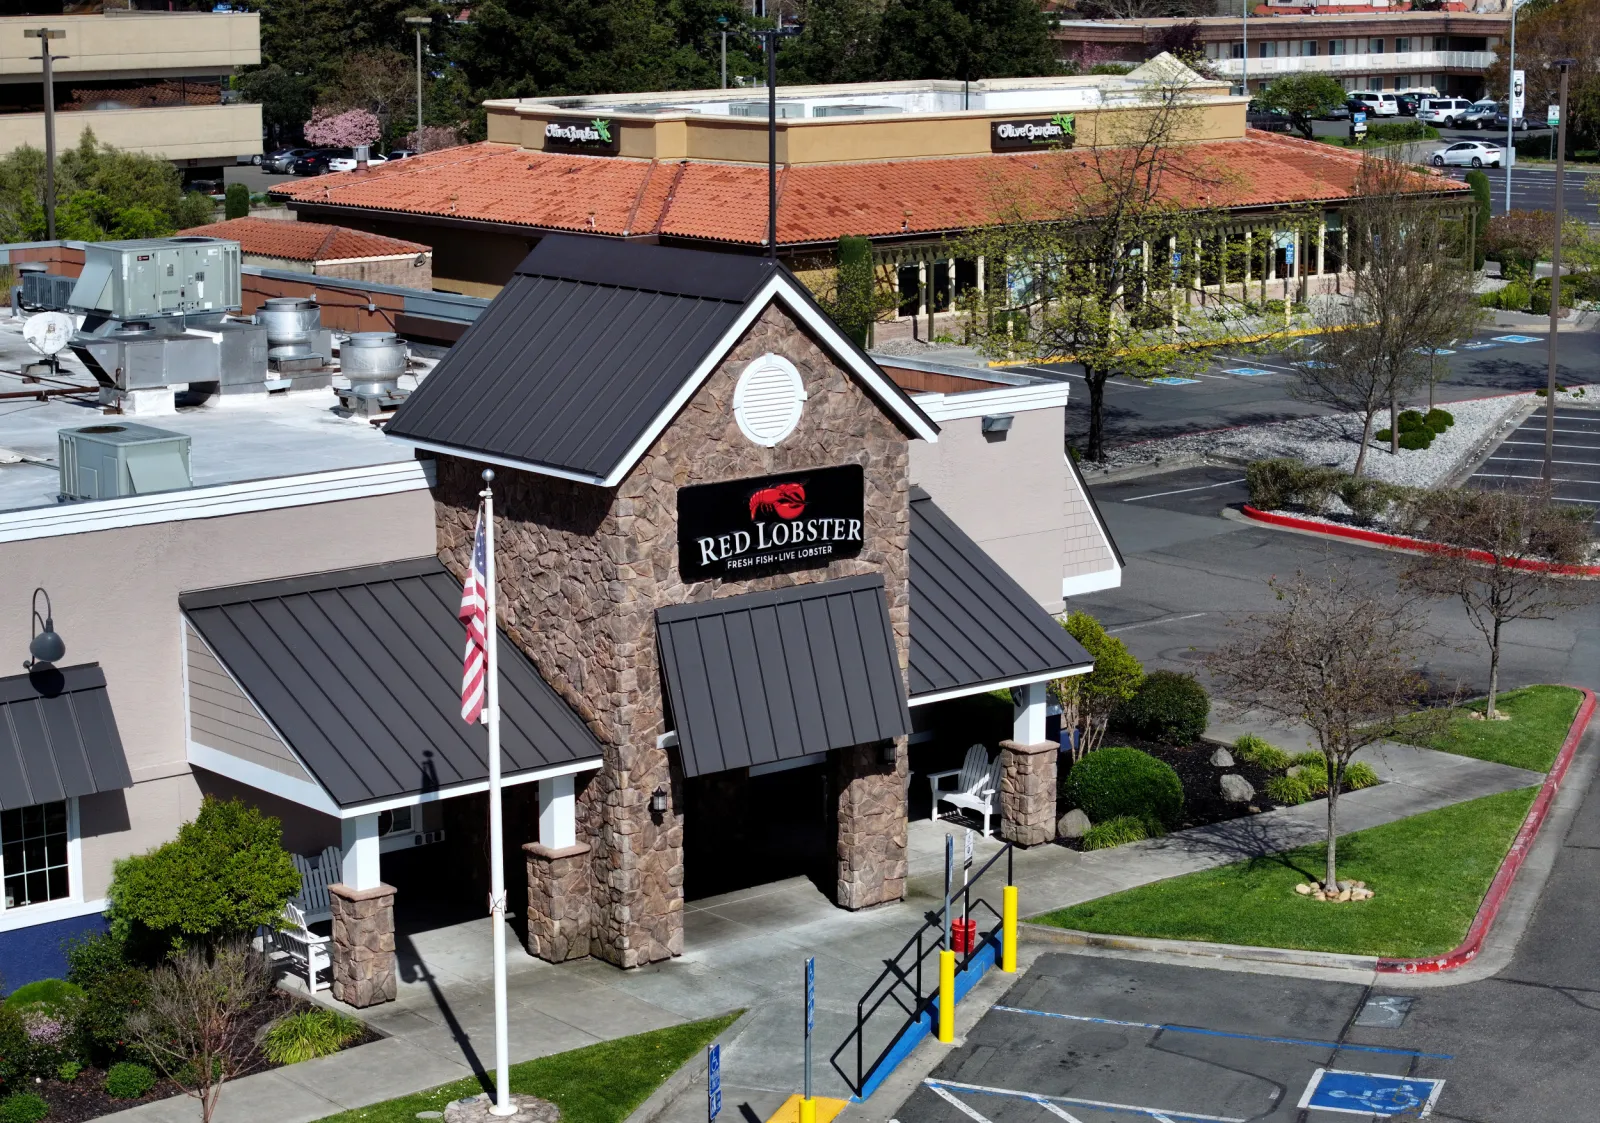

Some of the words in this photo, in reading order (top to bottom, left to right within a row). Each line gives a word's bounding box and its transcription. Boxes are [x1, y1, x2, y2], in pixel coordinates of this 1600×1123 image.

[997, 124, 1025, 138] Olive
[1024, 123, 1062, 140] Garden
[697, 530, 751, 567] RED
[756, 518, 862, 550] LOBSTER
[727, 557, 753, 569] FRESH
[798, 546, 833, 559] LOBSTER
